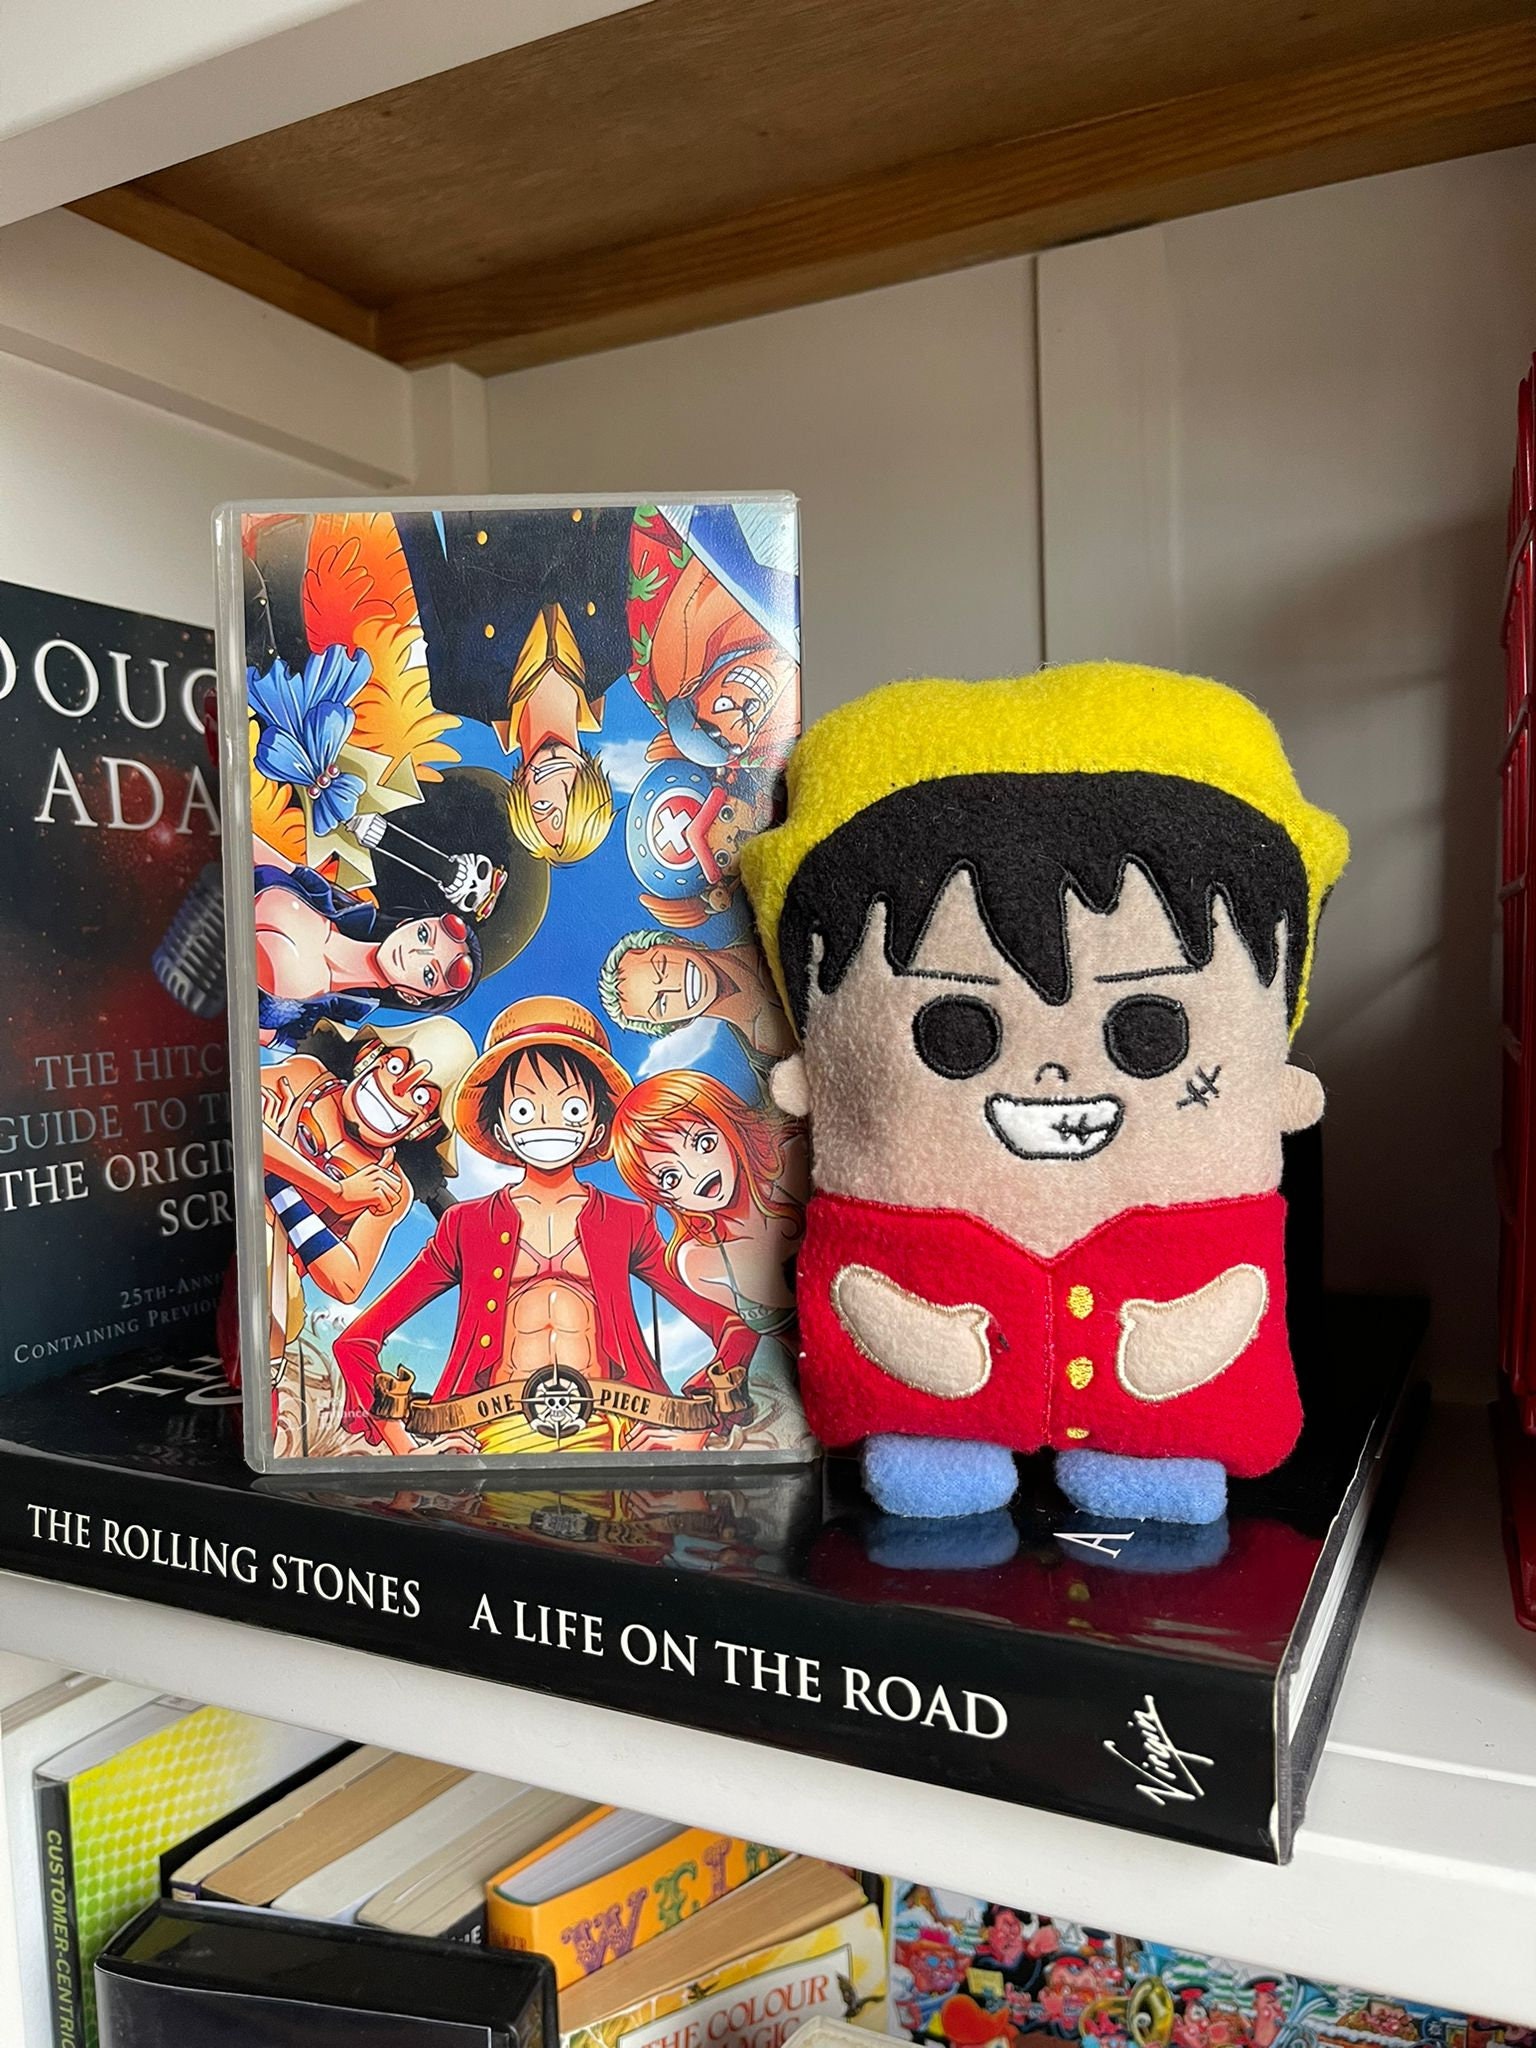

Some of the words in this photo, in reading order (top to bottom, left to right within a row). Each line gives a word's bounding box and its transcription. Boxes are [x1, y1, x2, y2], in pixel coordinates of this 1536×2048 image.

[35, 1052, 119, 1091] THE
[133, 1042, 229, 1082] HITC
[0, 1105, 123, 1154] GUIDE
[134, 1097, 187, 1134] TO
[0, 1160, 89, 1212] THE
[105, 1138, 234, 1193] ORIGI
[159, 1190, 234, 1237] SCR
[478, 1393, 516, 1418] ONE
[600, 1389, 650, 1416] PIECE
[27, 1503, 92, 1549] THE
[102, 1519, 258, 1584] ROLLING
[272, 1553, 421, 1618] STONES
[469, 1593, 502, 1635] A
[513, 1600, 604, 1657] LIFE
[620, 1623, 698, 1677] ON
[714, 1640, 822, 1703] THE
[841, 1666, 1009, 1740] ROAD
[1103, 1694, 1215, 1806] Virgin
[707, 1975, 829, 2042] COLOUR
